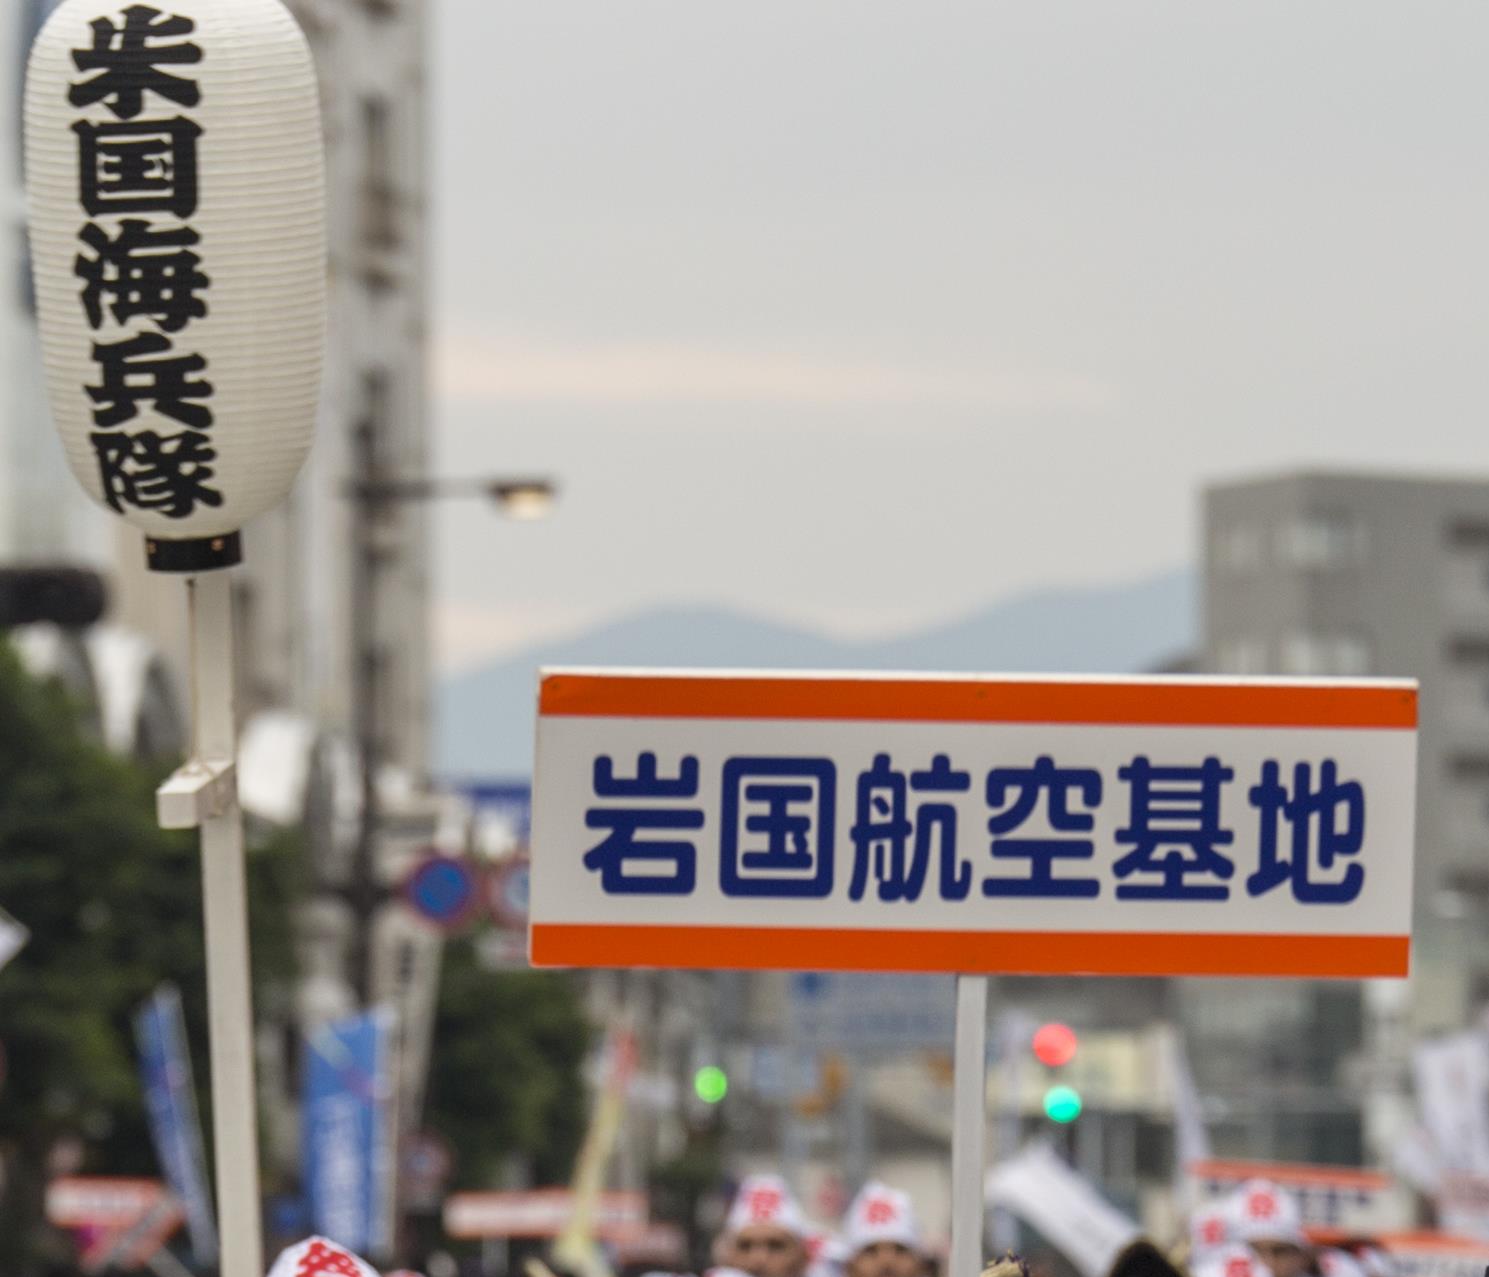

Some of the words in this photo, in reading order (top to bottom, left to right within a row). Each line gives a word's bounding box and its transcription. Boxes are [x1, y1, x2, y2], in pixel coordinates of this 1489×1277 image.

[67, 4, 224, 520] 米国海兵隊
[582, 750, 1367, 905] 岩国航空基地
